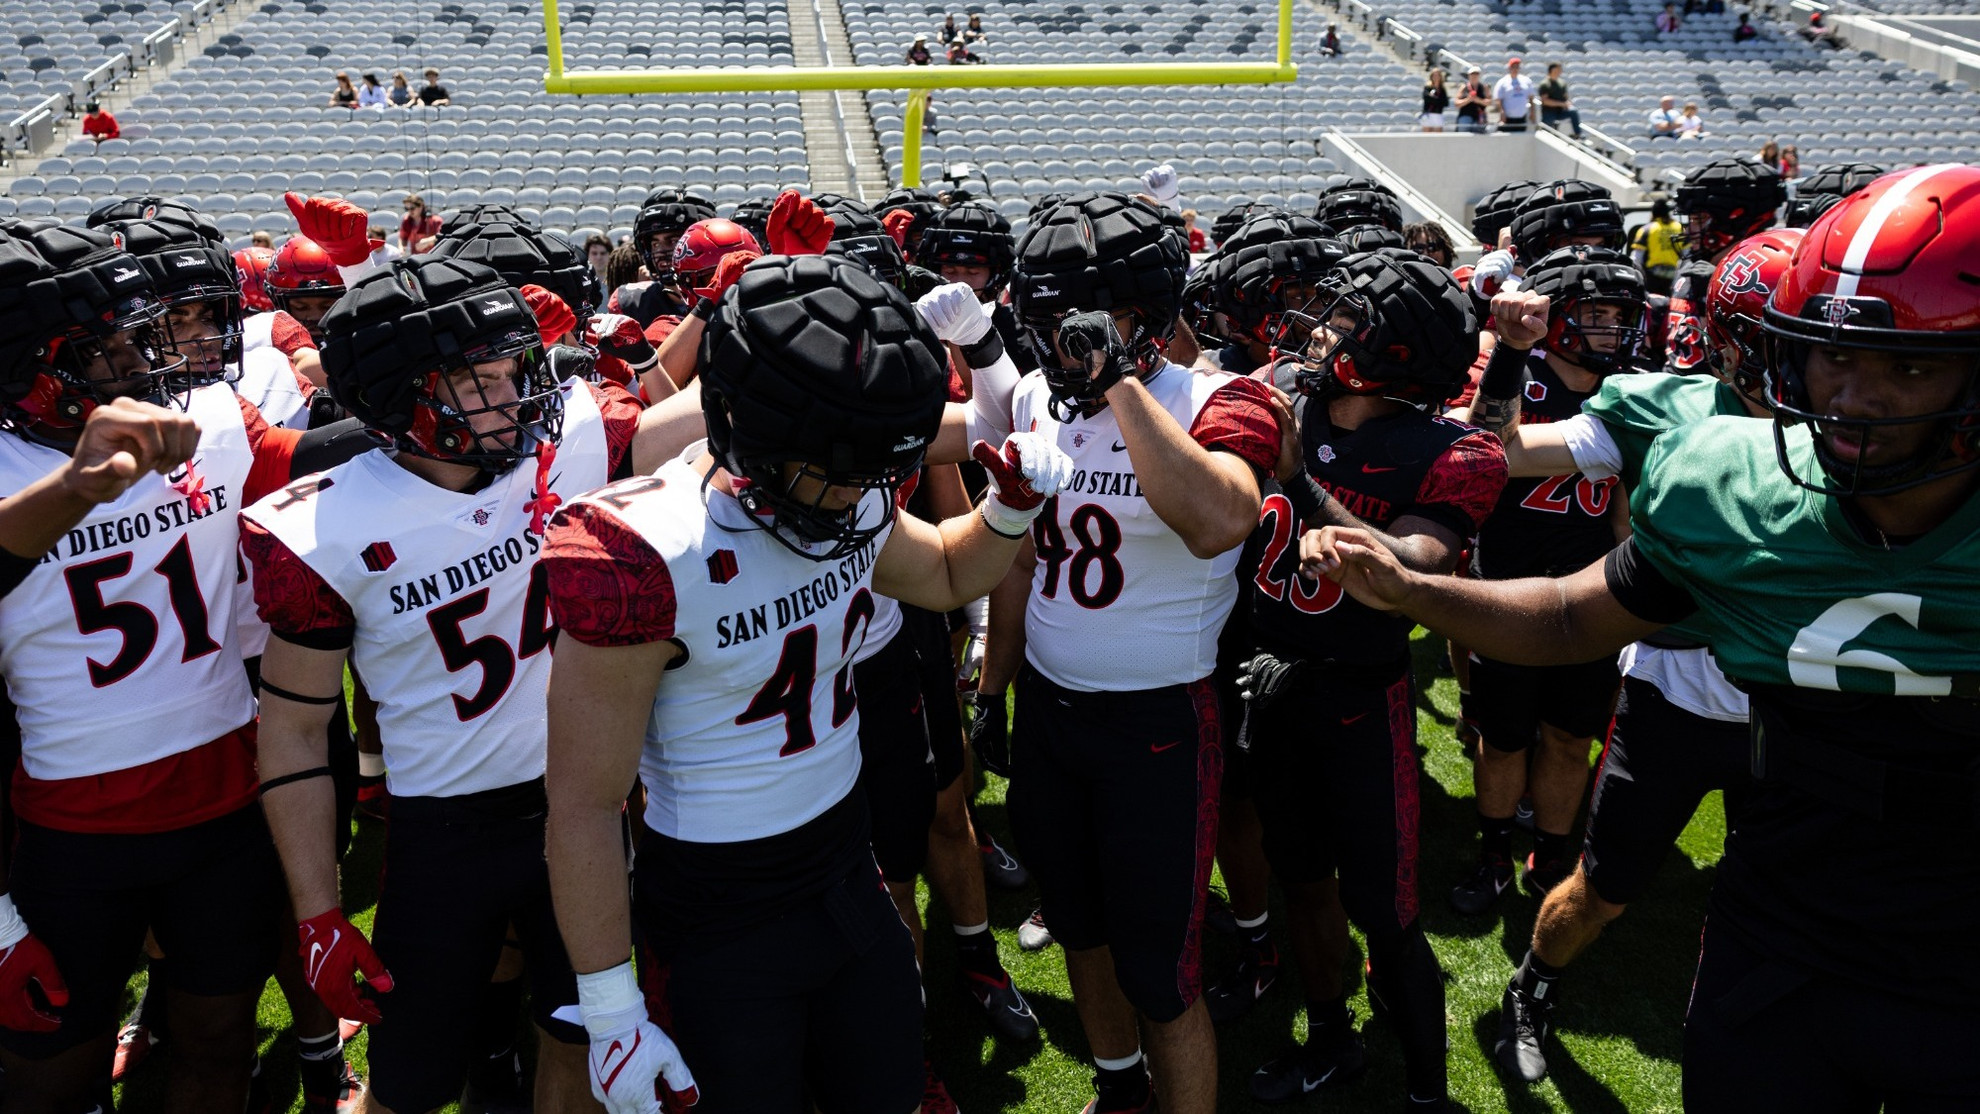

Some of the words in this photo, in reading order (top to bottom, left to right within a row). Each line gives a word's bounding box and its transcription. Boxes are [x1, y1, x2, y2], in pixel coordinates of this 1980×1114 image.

[483, 302, 514, 316] GUARDIAN
[68, 512, 150, 558] DIEGO
[389, 573, 442, 615] SAN
[442, 537, 523, 595] DIEGO
[1033, 493, 1124, 610] 48
[64, 531, 221, 688] 51
[716, 604, 768, 649] SAN
[773, 571, 839, 631] DIEGO
[839, 537, 877, 593] STATE
[735, 587, 876, 758] 42
